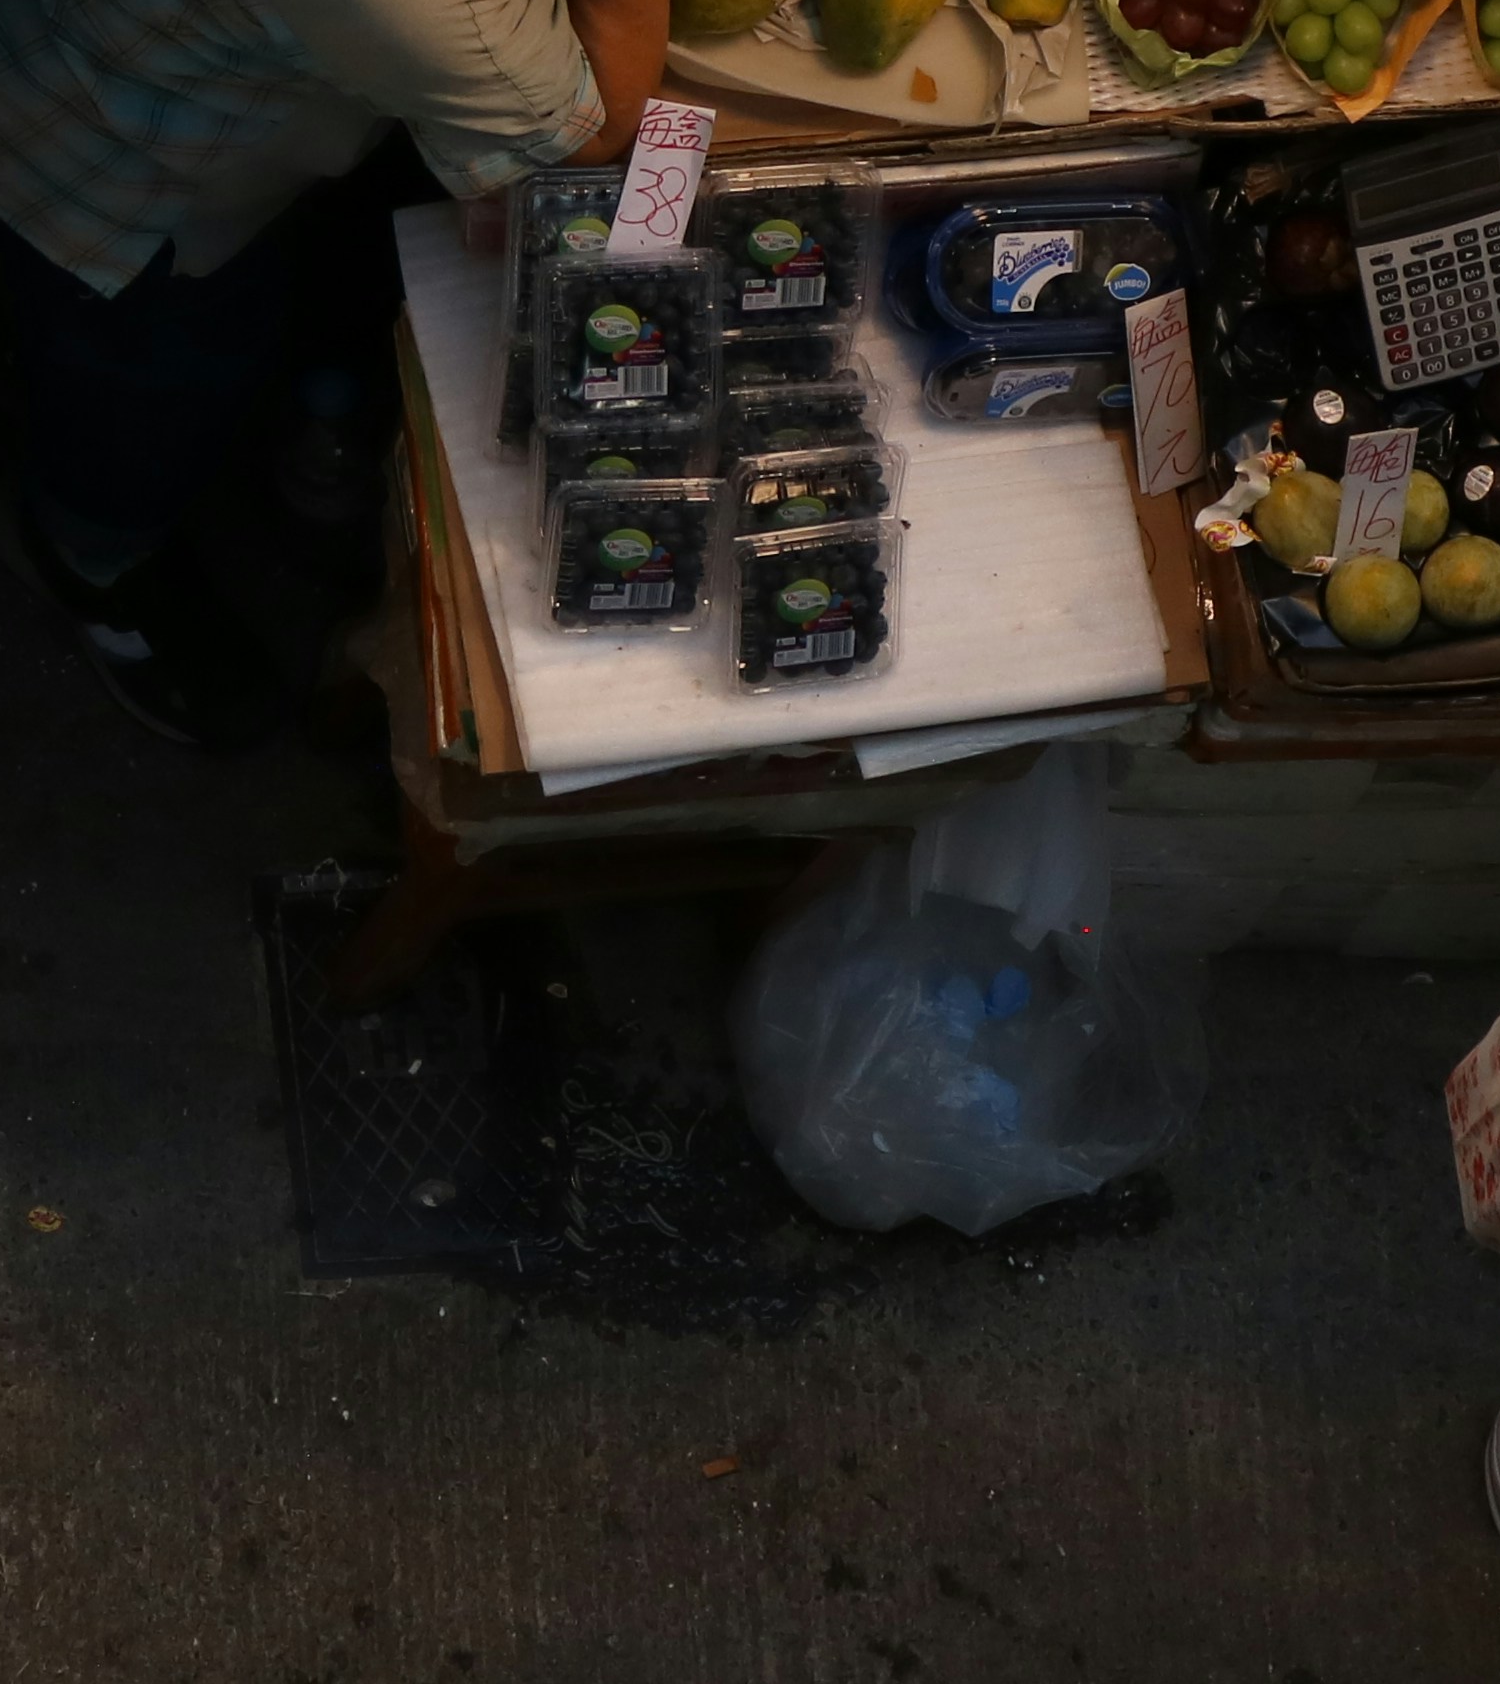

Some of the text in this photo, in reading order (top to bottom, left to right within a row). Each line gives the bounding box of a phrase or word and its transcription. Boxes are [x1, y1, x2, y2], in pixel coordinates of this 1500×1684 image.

[1460, 234, 1474, 244] ON
[997, 237, 1066, 280] Blueberries
[1113, 280, 1147, 291] JUMBO!
[1381, 291, 1399, 302] MC
[1410, 283, 1428, 295] MR
[1419, 288, 1482, 314] 7 8 9
[1392, 307, 1486, 341] C 4 5 6
[1393, 327, 1489, 361] AC 1 2 3
[1402, 361, 1443, 381] 0 00
